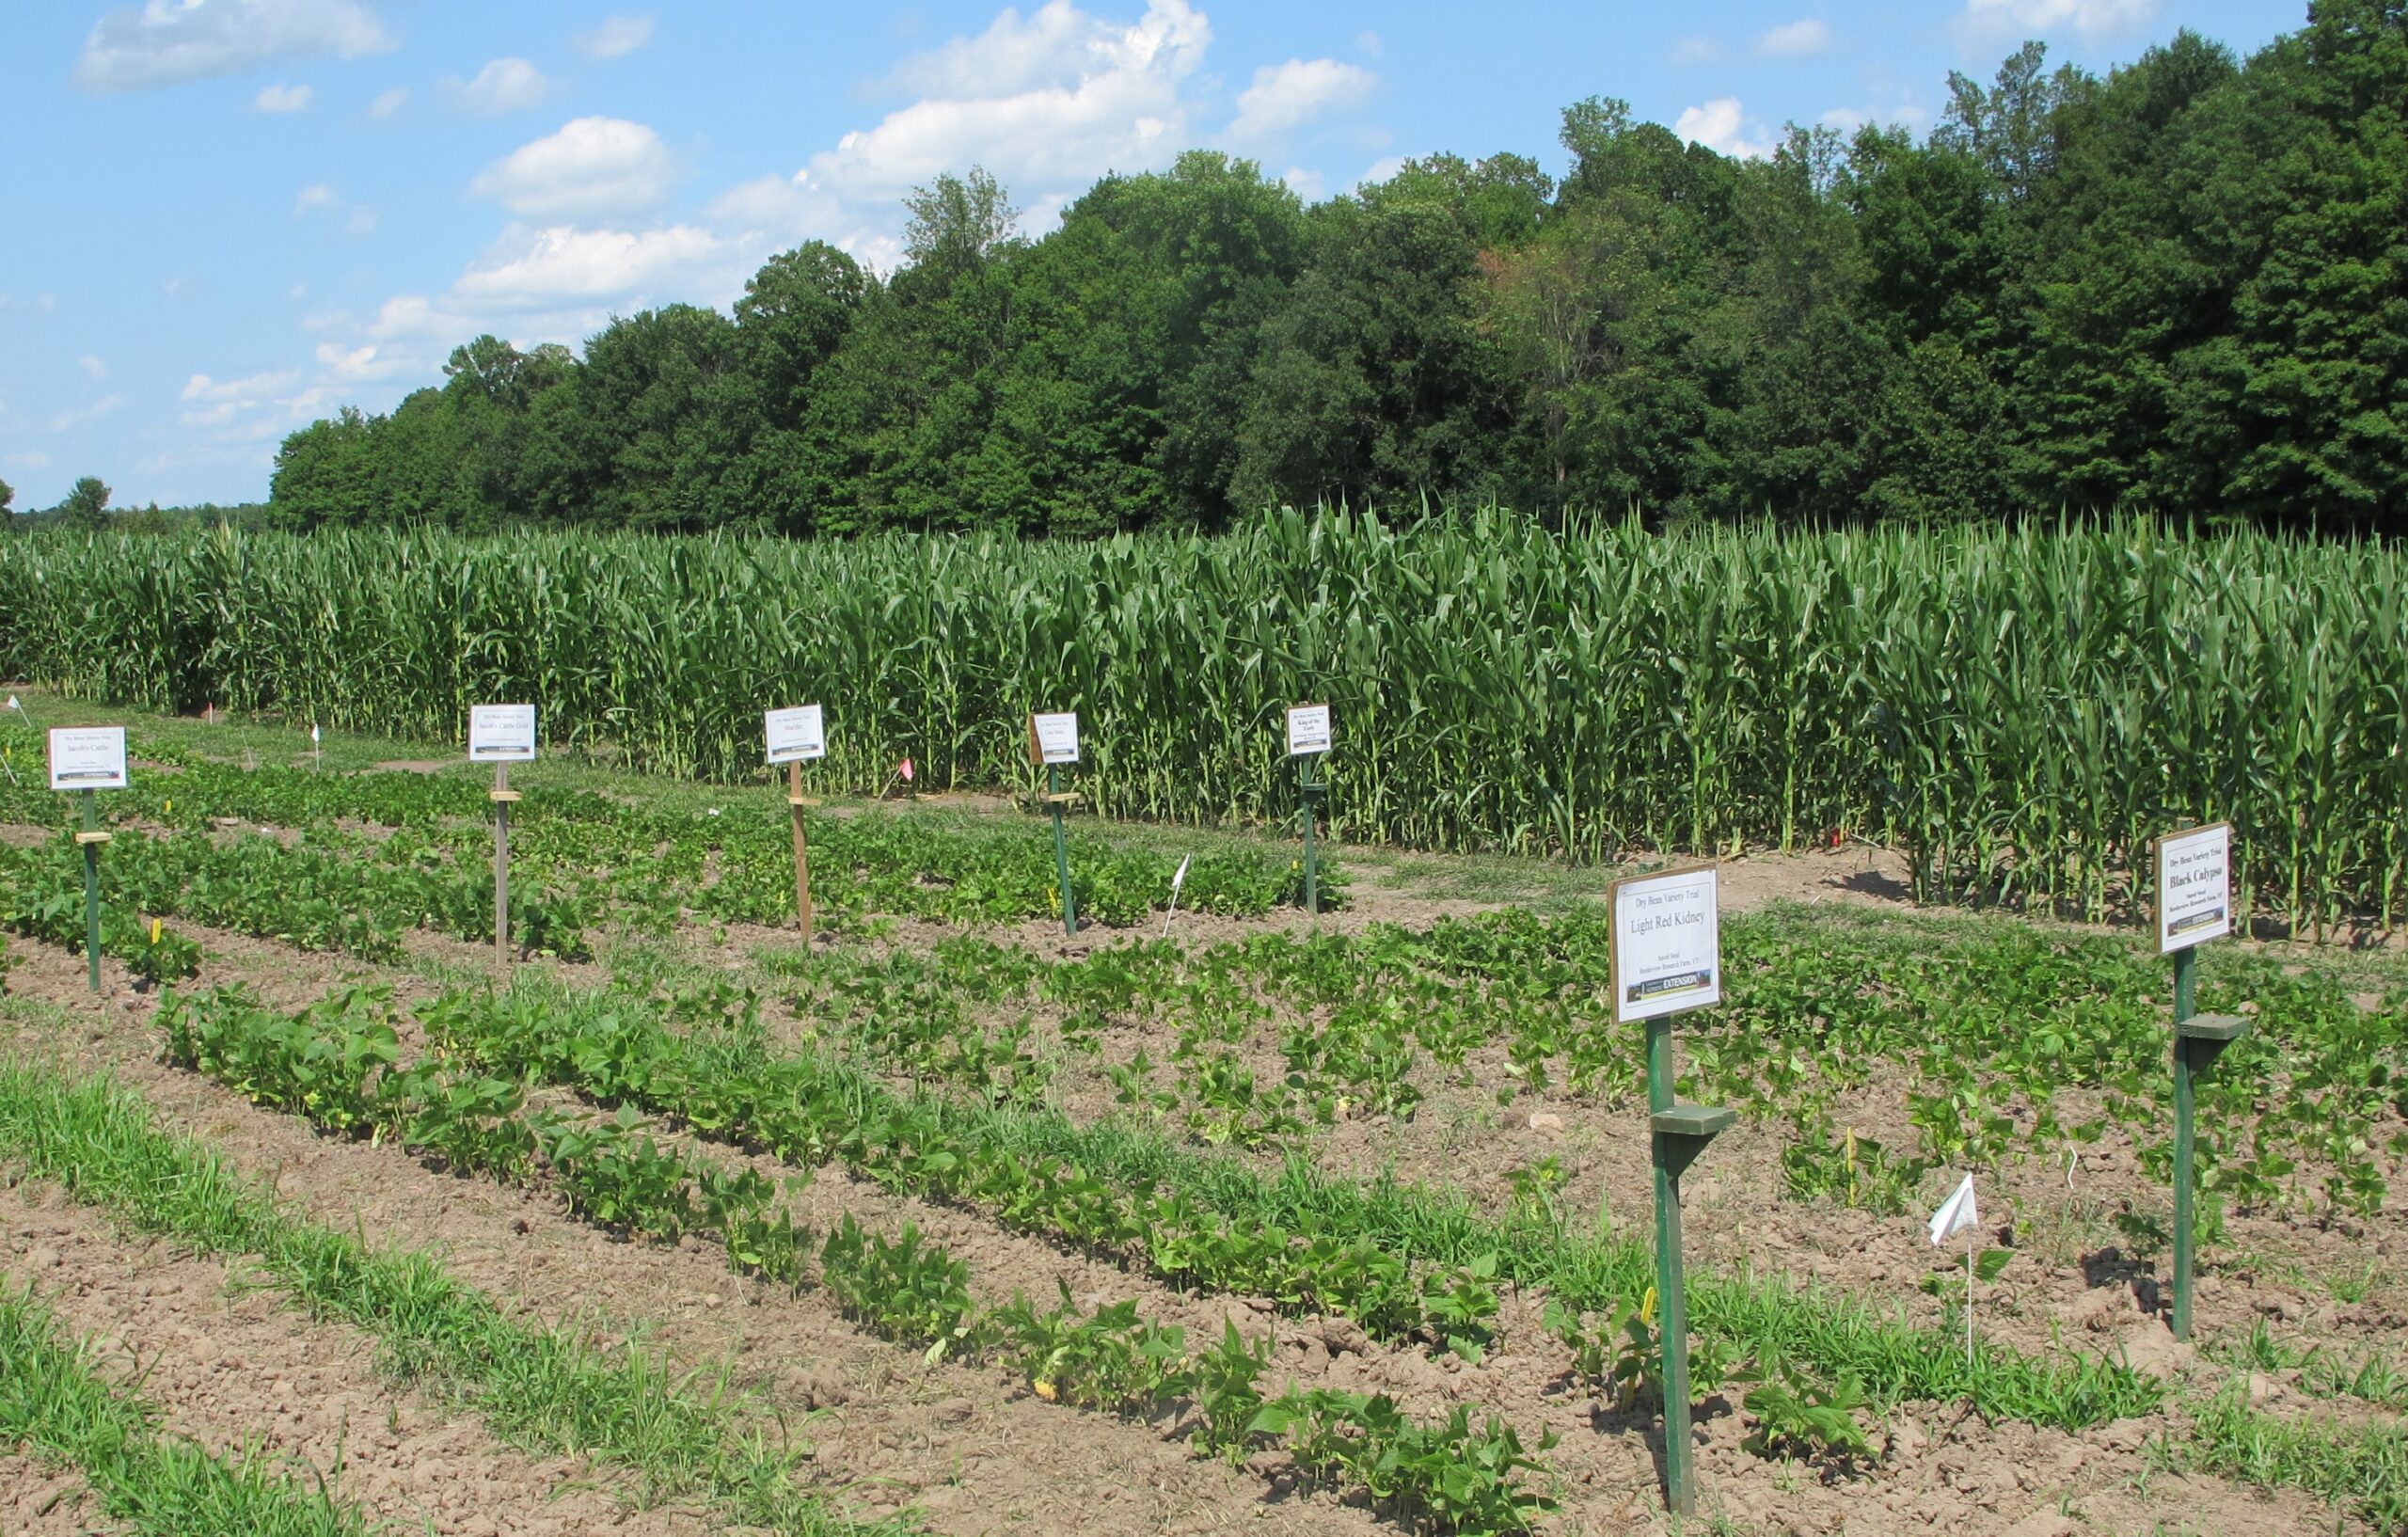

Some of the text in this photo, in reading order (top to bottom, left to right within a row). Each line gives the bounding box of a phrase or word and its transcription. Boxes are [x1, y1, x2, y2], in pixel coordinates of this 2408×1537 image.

[2169, 859, 2178, 868] Dry
[2170, 866, 2222, 889] Black Calypso
[1635, 888, 1700, 909] Dry Bean Variety Trial
[1631, 911, 1704, 935] Light Red Kidney
[1663, 974, 1697, 989] EXTENSION
